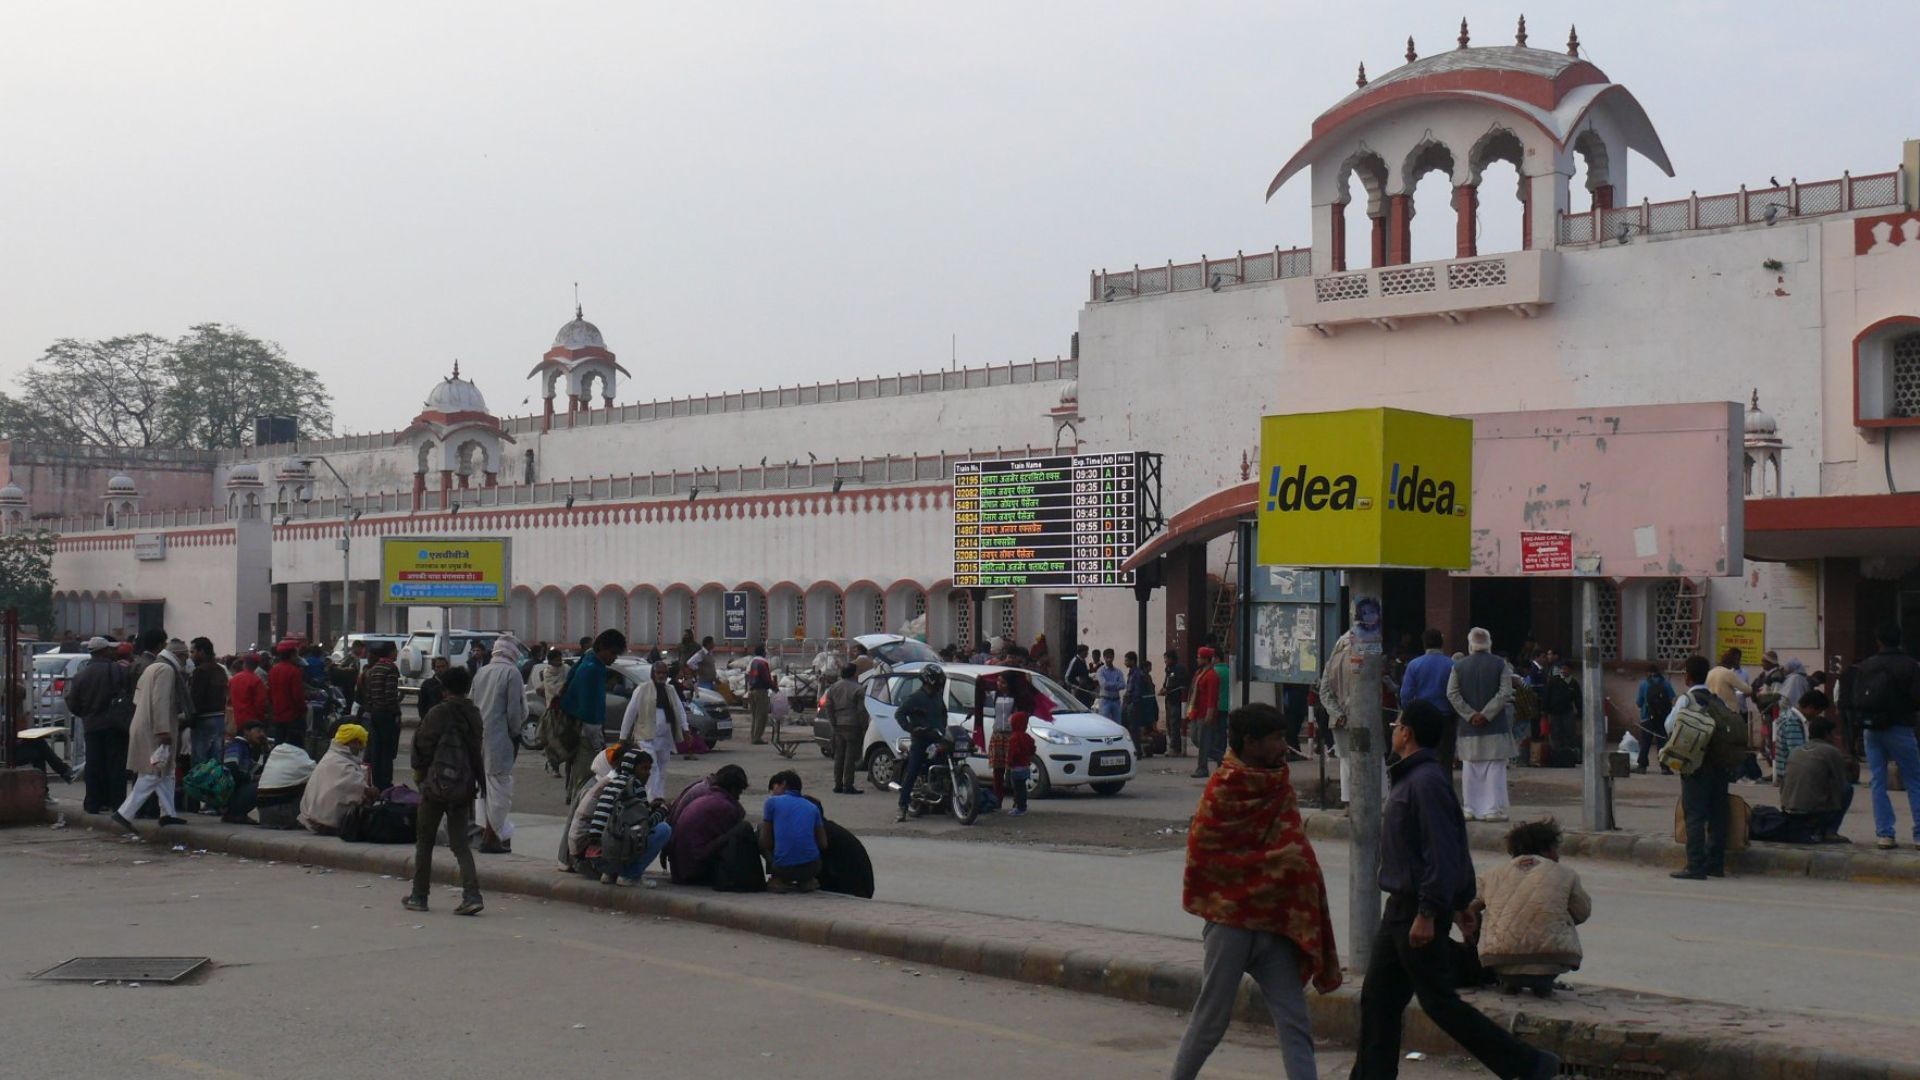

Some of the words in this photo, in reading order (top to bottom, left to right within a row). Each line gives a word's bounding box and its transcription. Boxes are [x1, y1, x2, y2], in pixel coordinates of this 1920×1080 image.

[1011, 462, 1024, 470] Train
[1025, 461, 1042, 469] Name
[1076, 469, 1098, 479] 09:30
[1105, 468, 1112, 478] A
[1121, 467, 1127, 476] 3
[1076, 482, 1098, 492] 09:35
[1105, 481, 1112, 491] A
[1121, 480, 1127, 490] 6
[1076, 495, 1098, 505] 09:40
[1105, 495, 1112, 504] A
[1121, 493, 1127, 503] 5
[1076, 508, 1098, 518] 09:45
[1105, 508, 1112, 517] A
[1121, 506, 1127, 516] 2
[1076, 522, 1098, 531] 09:55
[1105, 521, 1112, 530] D
[1121, 520, 1127, 529] 2
[1077, 535, 1098, 544] 10:00
[1105, 534, 1112, 544] A
[1121, 533, 1127, 542] 3
[956, 538, 978, 547] 12414
[1077, 548, 1098, 557] 10:10
[1105, 548, 1112, 557] D
[1121, 546, 1127, 556] 6
[956, 563, 978, 572] 12015
[1077, 561, 1098, 570] 10:35
[1106, 561, 1112, 570] A
[1077, 574, 1098, 584] 10:45
[1106, 573, 1112, 584] A
[1121, 572, 1127, 582] 4
[734, 595, 741, 607] P
